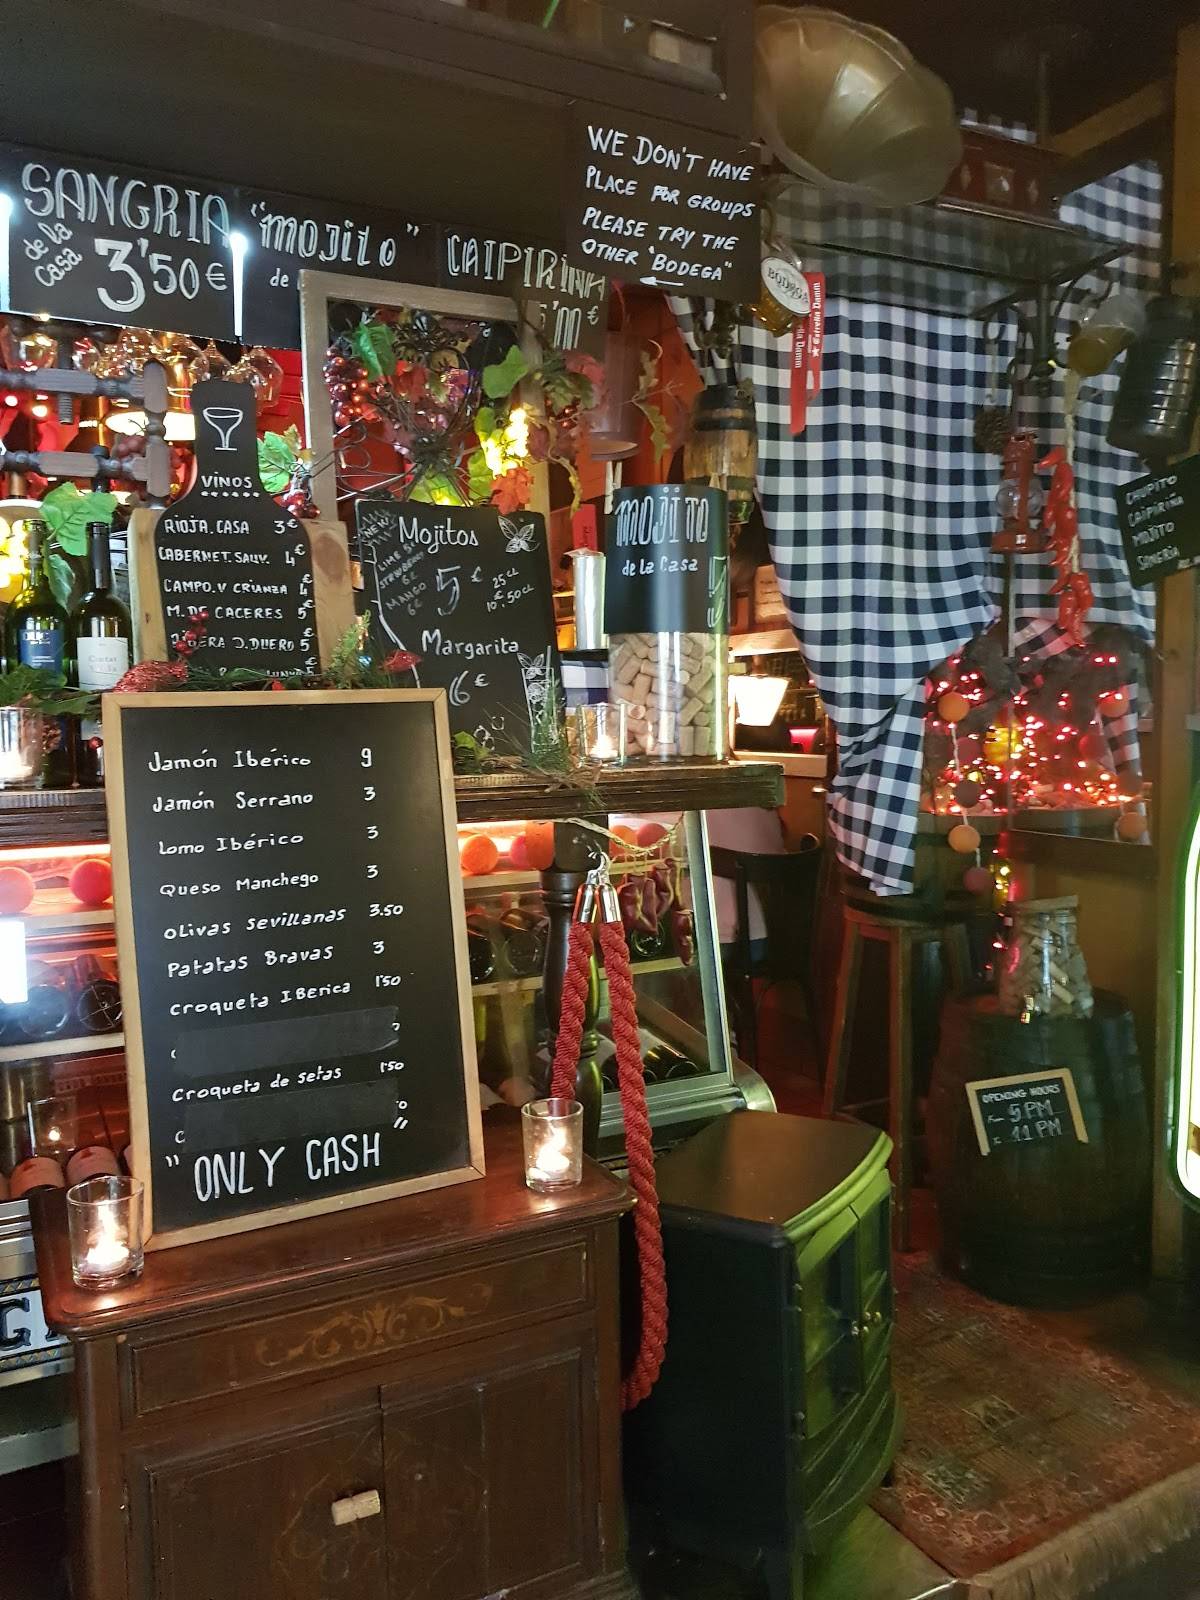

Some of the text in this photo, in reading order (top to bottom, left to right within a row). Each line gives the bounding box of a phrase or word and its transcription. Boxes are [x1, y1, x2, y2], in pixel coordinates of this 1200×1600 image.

[587, 125, 755, 182] WE DON'T HAVE
[22, 163, 231, 249] SANGRIA
[585, 165, 638, 196] PLACE
[687, 194, 755, 221] GROUPS
[23, 222, 73, 260] de la
[582, 206, 739, 251] PLEASE TRY THE
[581, 238, 640, 266] OTHER
[812, 282, 823, 309] Damm
[363, 517, 390, 537] NEW
[399, 516, 479, 554] Mojitos
[621, 559, 636, 577] de
[385, 582, 427, 610] MANGO
[215, 607, 283, 620] CACERES
[421, 629, 519, 660] Margarita
[148, 749, 217, 772] Jamón
[232, 748, 311, 768] Ibérico
[152, 786, 376, 813] Jamón Serrano 3
[215, 833, 304, 852] Ibérico
[366, 825, 379, 839] 3
[159, 864, 379, 897] Queso Manchego 3
[264, 945, 334, 966] Bravas
[372, 941, 385, 955] 3
[270, 1073, 290, 1088] de
[982, 1088, 1027, 1104] OPENING
